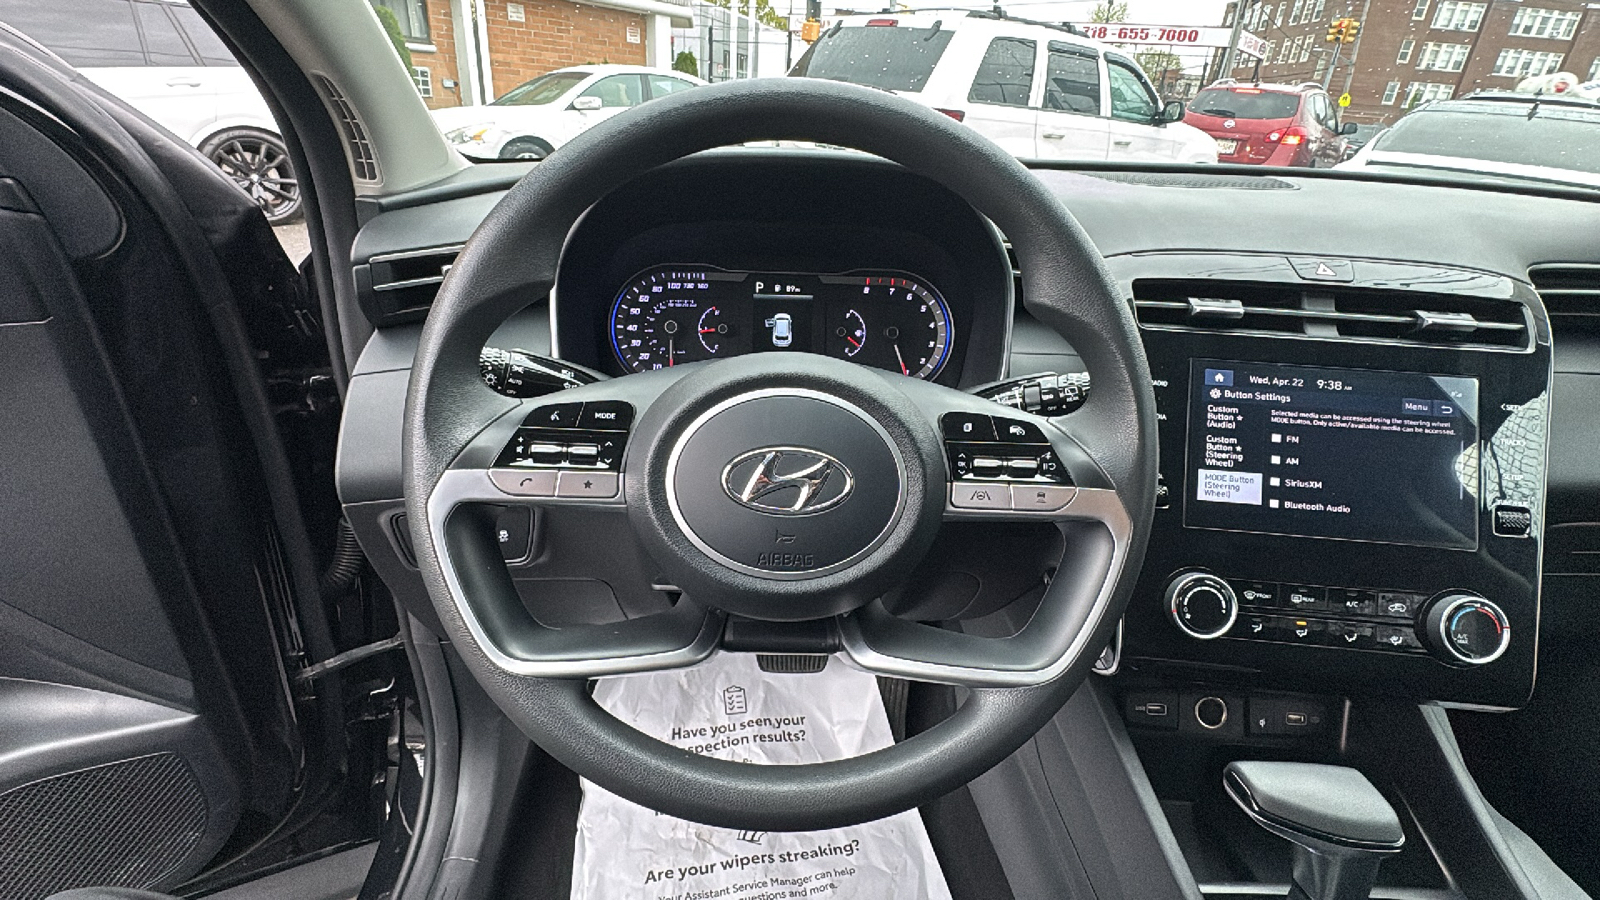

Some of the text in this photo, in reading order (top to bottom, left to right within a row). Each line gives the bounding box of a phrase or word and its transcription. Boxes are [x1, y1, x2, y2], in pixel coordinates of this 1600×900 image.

[755, 282, 764, 293] P
[626, 324, 638, 332] 40
[638, 352, 650, 360] 20
[1249, 375, 1304, 387] Wed, Apr. 22
[1316, 379, 1343, 391] 9:38
[1224, 390, 1291, 404] Button Settings
[1207, 404, 1239, 414] Custom
[1405, 402, 1428, 411] Menu
[594, 412, 617, 420] MODE
[1207, 412, 1234, 422] Button
[1271, 409, 1299, 418] Selected
[1299, 411, 1319, 419] media
[1332, 413, 1341, 421] be
[1342, 415, 1372, 423] accessed
[1373, 417, 1391, 425] using
[1391, 417, 1402, 425] the
[1403, 418, 1430, 428] steering
[1206, 420, 1236, 430] (Audio)
[1312, 419, 1328, 428] Only
[1414, 426, 1424, 434] be
[1206, 434, 1238, 444] Custom
[1286, 435, 1300, 444] FM
[1206, 443, 1233, 452] Button
[1205, 450, 1244, 462] (Steering
[1285, 457, 1300, 466] AM
[1205, 458, 1234, 468] Wheel)
[1204, 473, 1255, 484] MODE Button
[1284, 478, 1323, 489] SiriusXM
[1204, 482, 1241, 492] (Steering
[1204, 490, 1231, 499] Wheel)
[1284, 500, 1351, 514] Bluetooth Audio
[756, 552, 814, 568] AIRBAG
[671, 716, 806, 741] Have you seen your
[753, 729, 806, 744] results?
[645, 839, 861, 884] Are your wipers streaking?
[684, 886, 731, 900] Assistant
[732, 880, 768, 894] Service
[769, 874, 813, 888] Manager
[814, 870, 833, 881] can
[833, 866, 857, 877] help
[788, 887, 808, 898] and
[809, 882, 839, 896] more.
